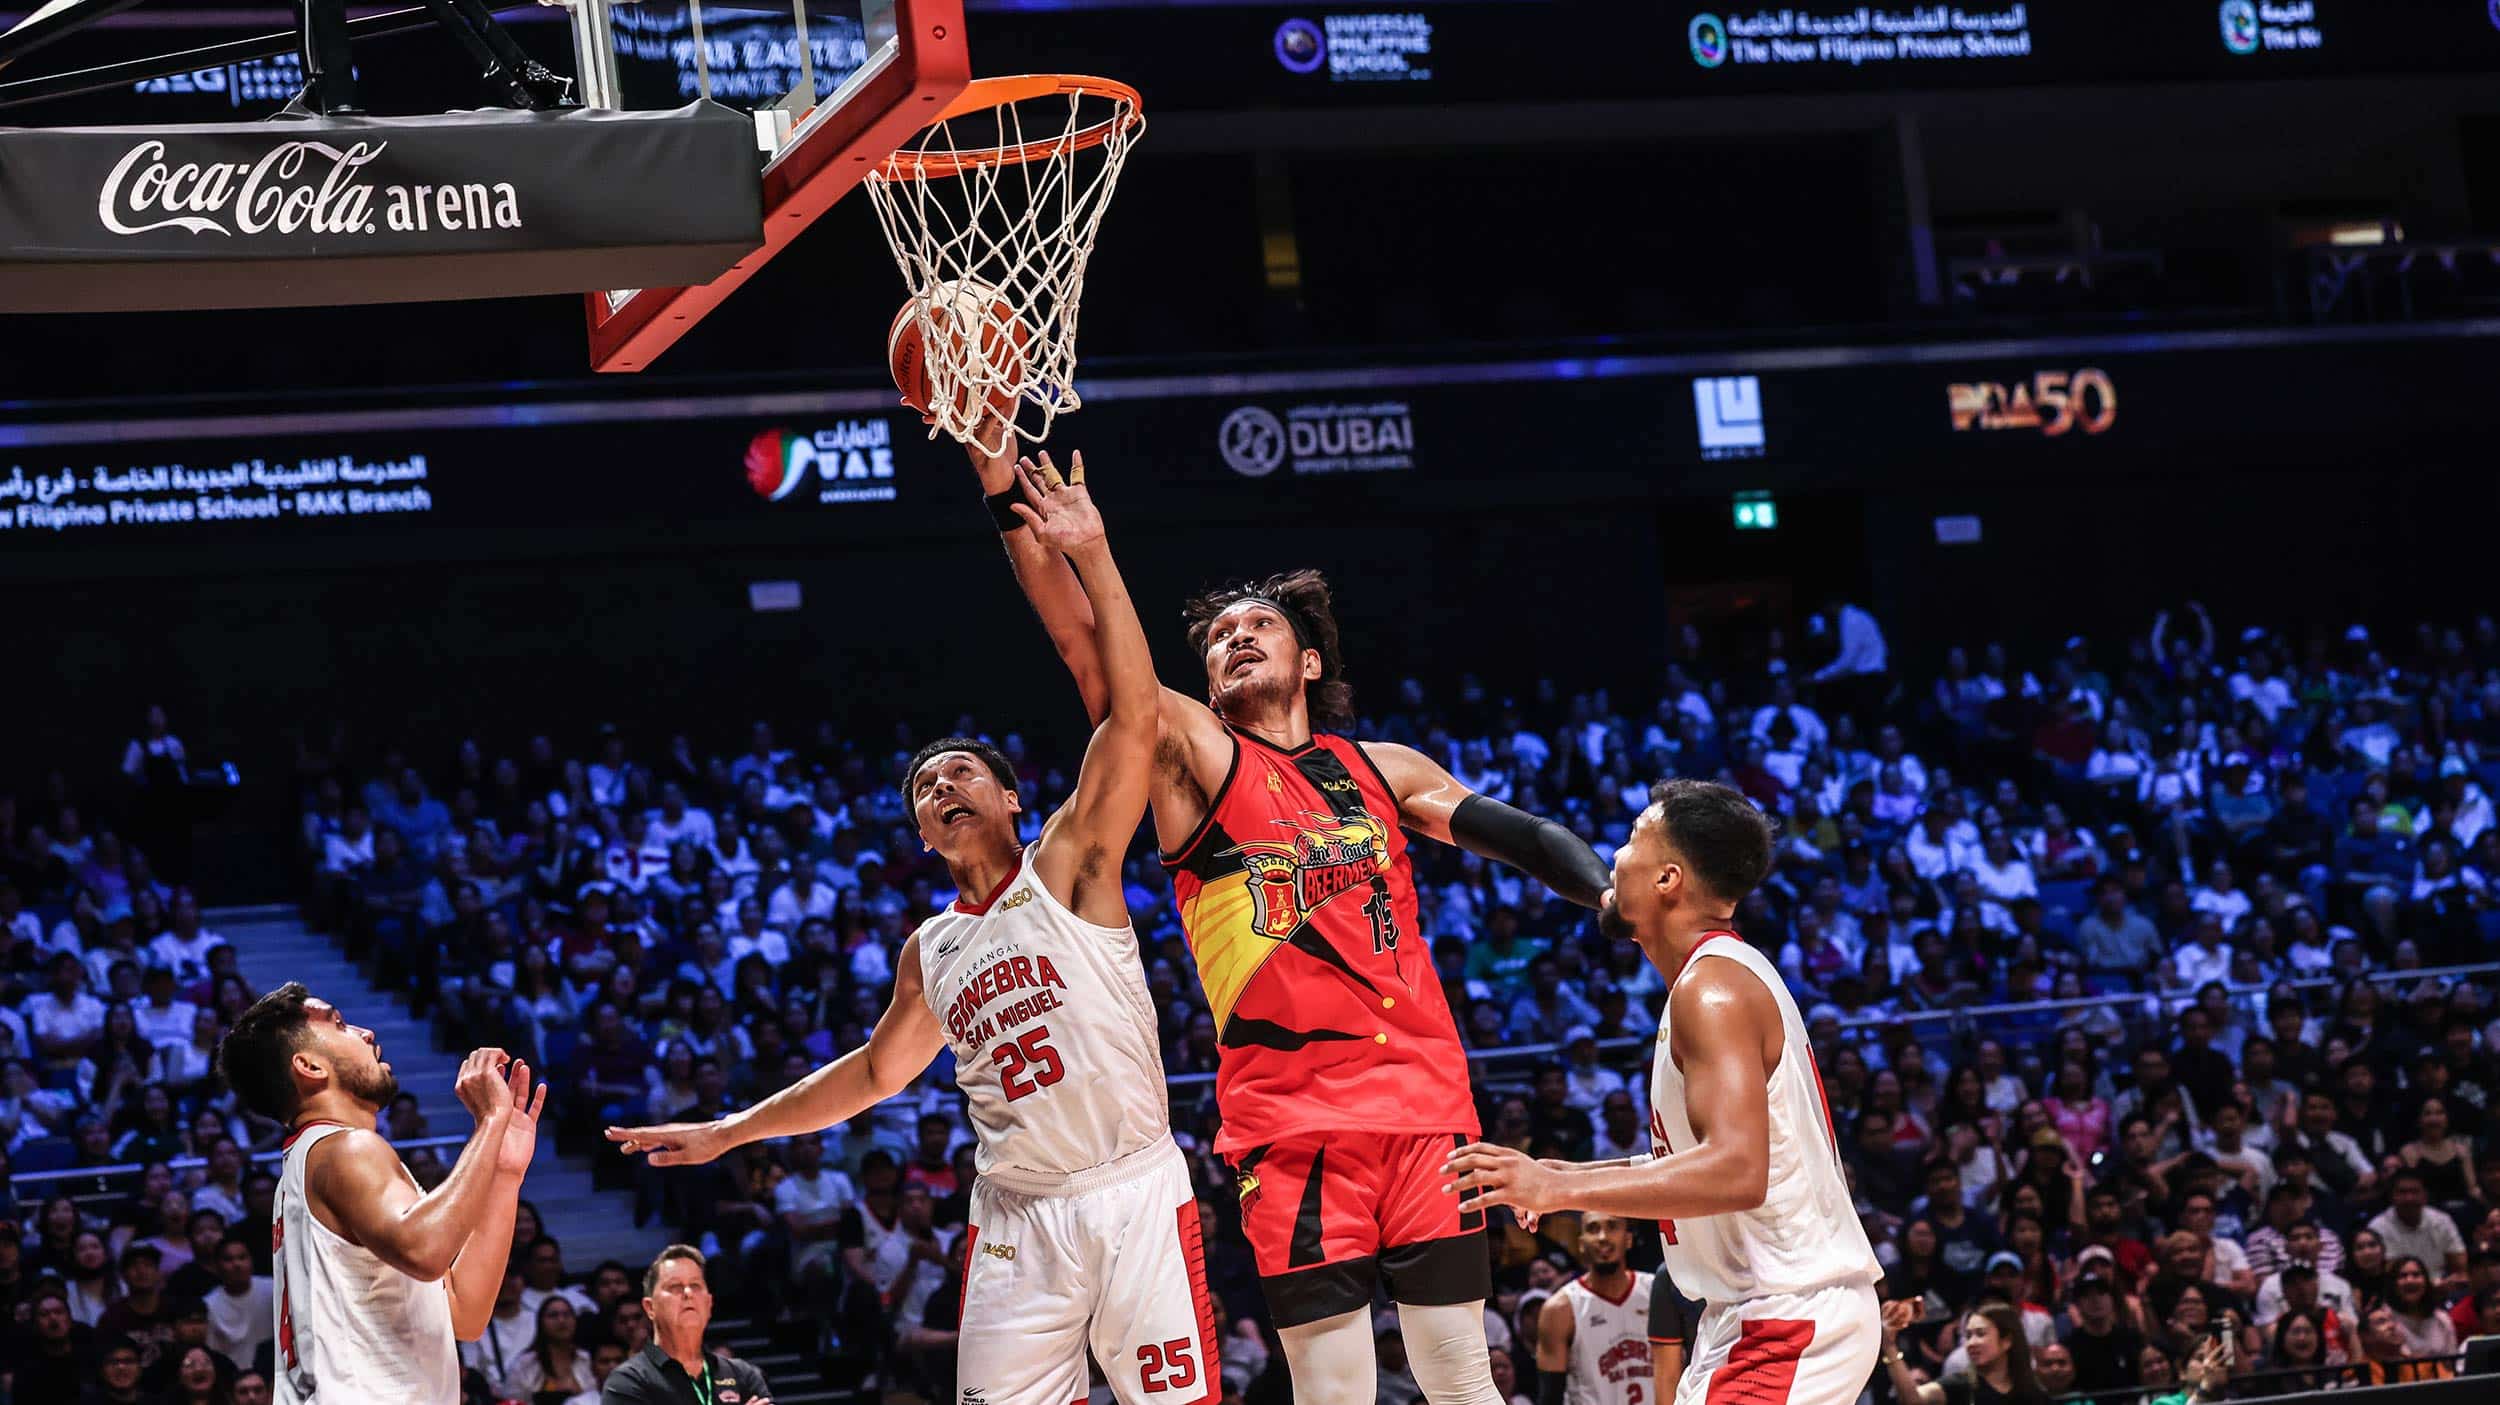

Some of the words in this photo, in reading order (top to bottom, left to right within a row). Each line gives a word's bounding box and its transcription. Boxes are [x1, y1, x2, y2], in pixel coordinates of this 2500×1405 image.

[1731, 38, 1770, 64] The
[1819, 35, 1896, 66] Filipino
[1963, 30, 2031, 57] School
[98, 139, 388, 236] Coca-Cola
[386, 182, 523, 232] arena
[817, 449, 896, 480] UAE
[1289, 415, 1414, 457] DUBAI
[16, 501, 107, 531] Filipino
[109, 498, 195, 525] Private
[197, 491, 280, 521] School
[296, 490, 347, 516] RAK
[347, 484, 432, 514] Branch
[1304, 854, 1380, 910] BEERMEN
[1361, 888, 1401, 955] 15
[957, 943, 1021, 986] BARANGAY
[948, 955, 1067, 1042] GINEBRA
[965, 1017, 997, 1051] SAN
[1000, 989, 1064, 1033] MIGUEL
[991, 1025, 1065, 1103] 25
[1136, 1336, 1197, 1394] 25
